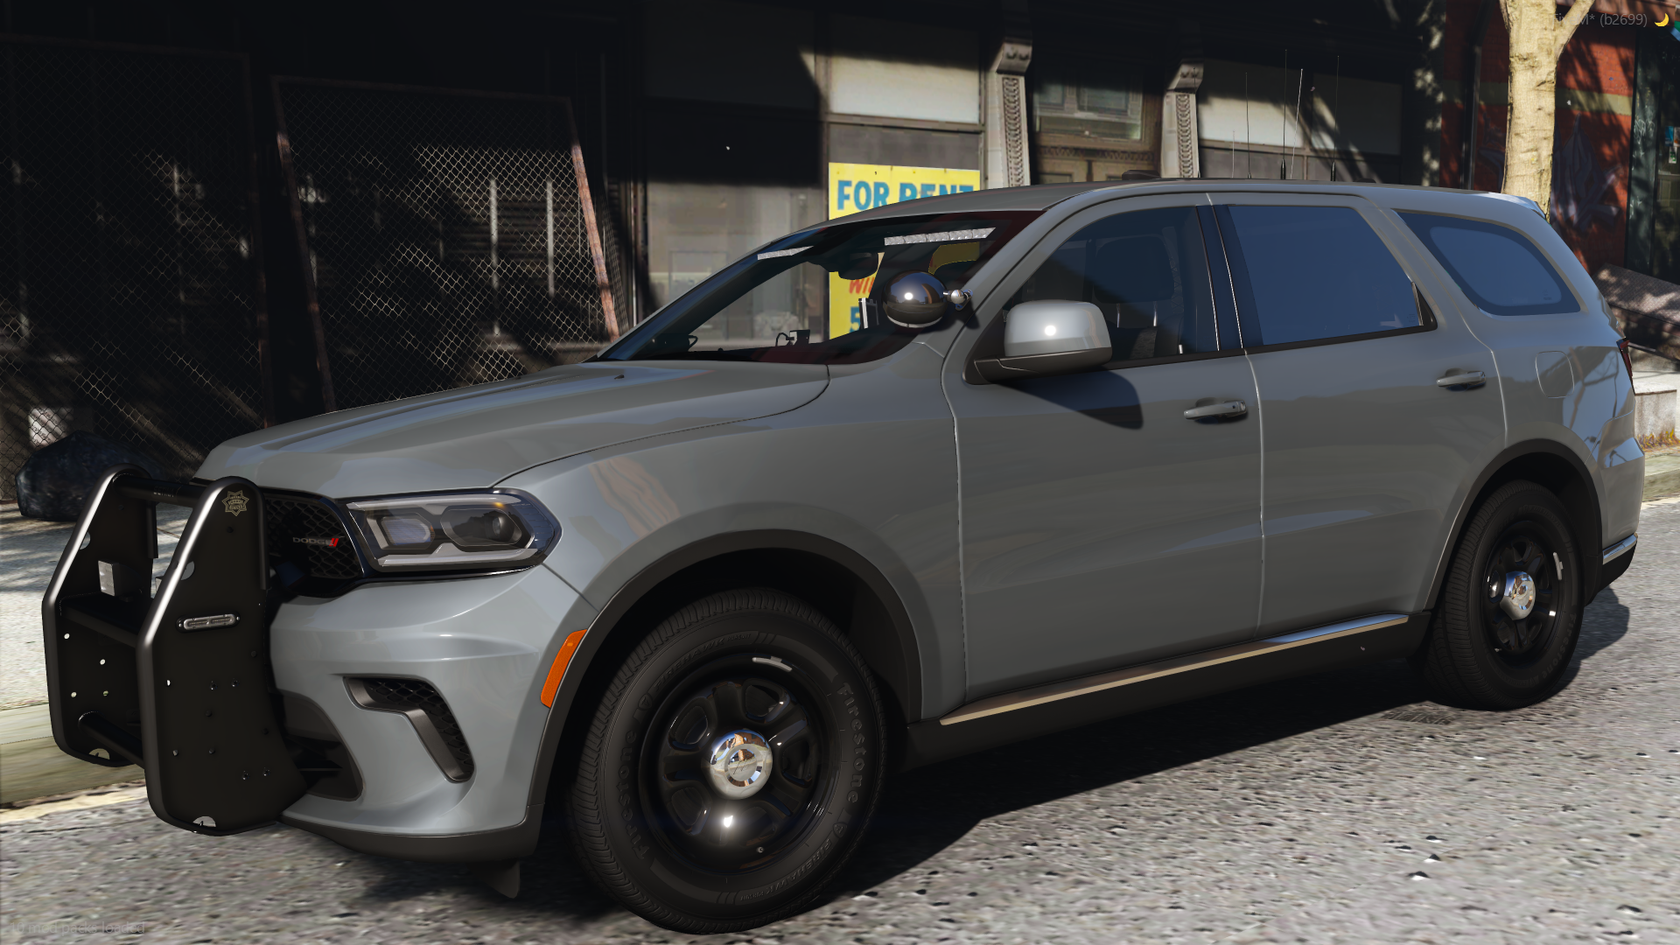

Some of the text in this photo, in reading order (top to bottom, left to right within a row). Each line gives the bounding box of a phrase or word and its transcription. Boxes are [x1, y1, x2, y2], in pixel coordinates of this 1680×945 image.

[837, 180, 890, 211] FOR
[292, 536, 334, 547] DODGE
[653, 637, 725, 691] FIREHAWK
[837, 682, 867, 804] Firestone
[616, 730, 650, 860] Firestone
